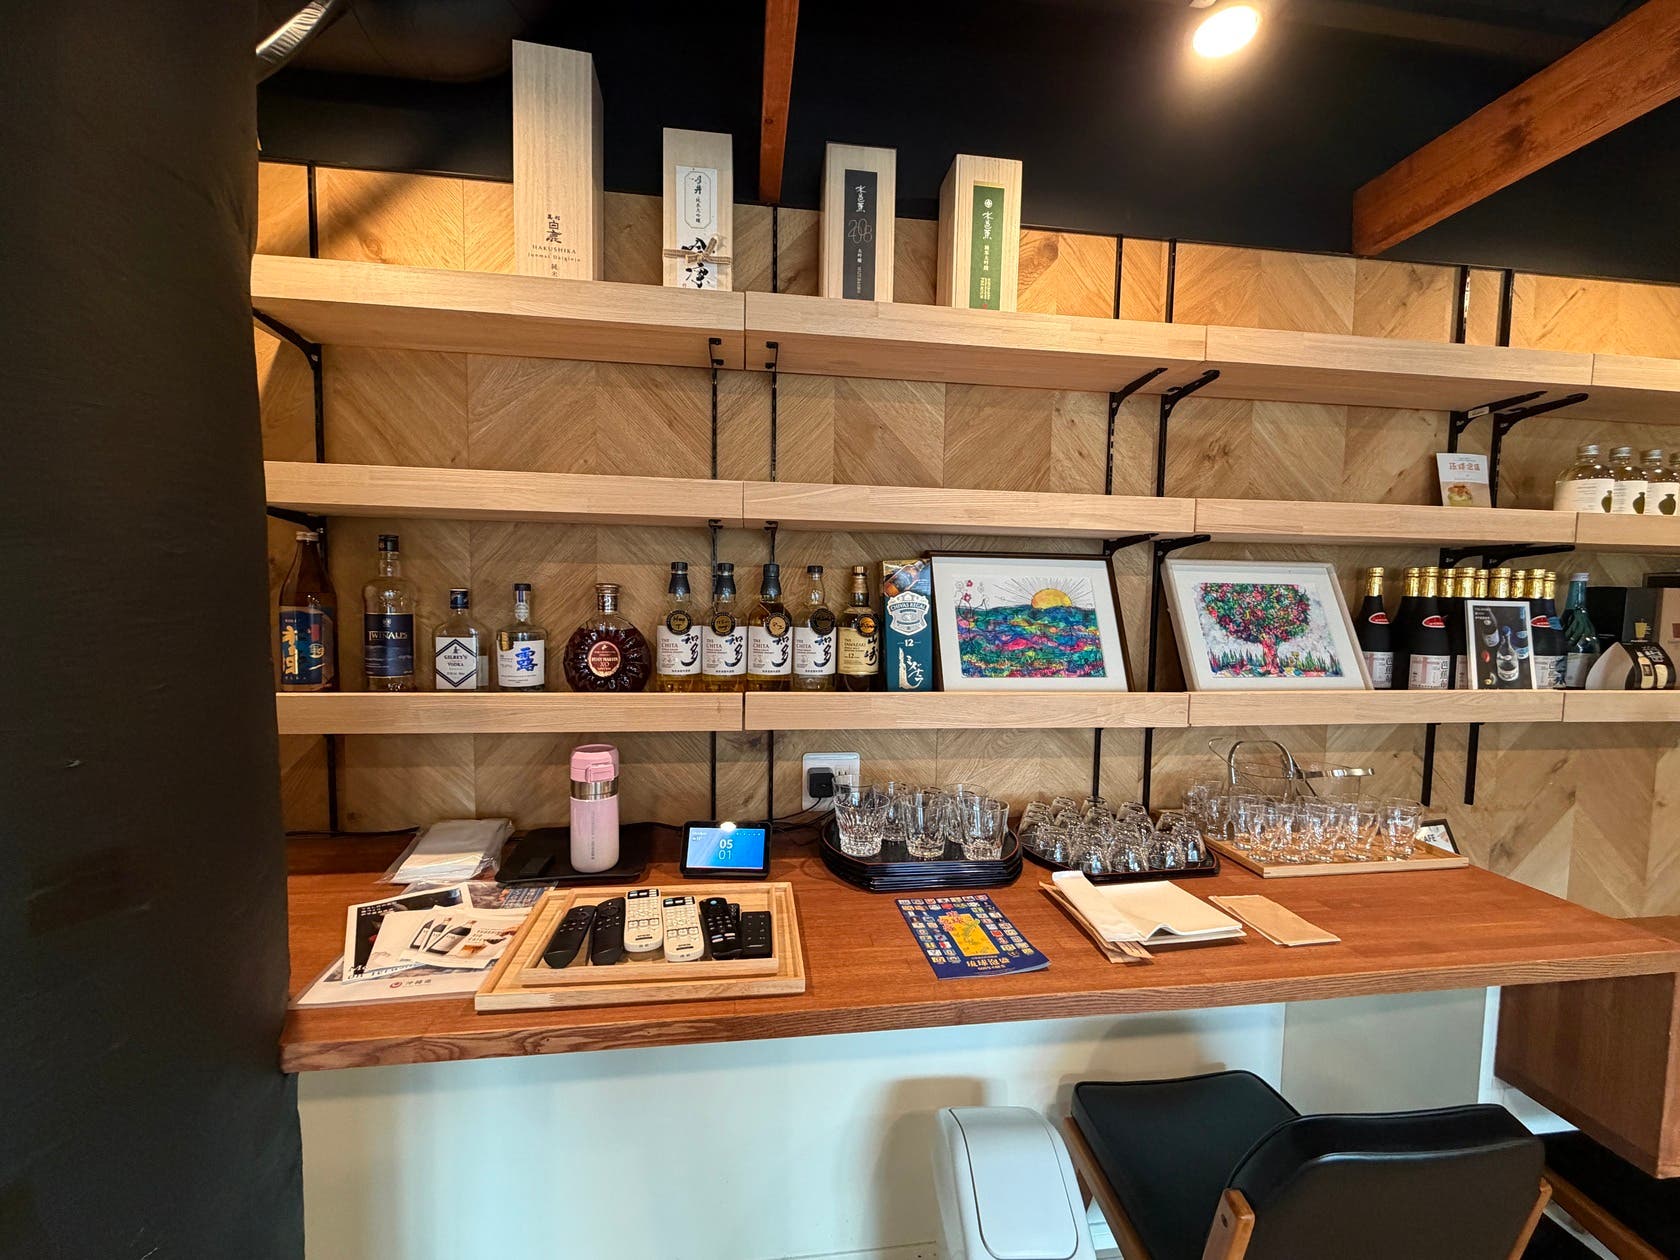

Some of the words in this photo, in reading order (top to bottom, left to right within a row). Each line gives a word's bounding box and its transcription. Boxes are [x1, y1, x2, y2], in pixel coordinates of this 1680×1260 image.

[545, 220, 563, 244] 白鹿
[532, 244, 577, 255] HAKUSHIKA
[890, 602, 909, 611] CHIVAS
[910, 602, 926, 610] REGAL
[904, 638, 914, 647] 12
[719, 838, 733, 849] 05
[718, 849, 731, 860] 01
